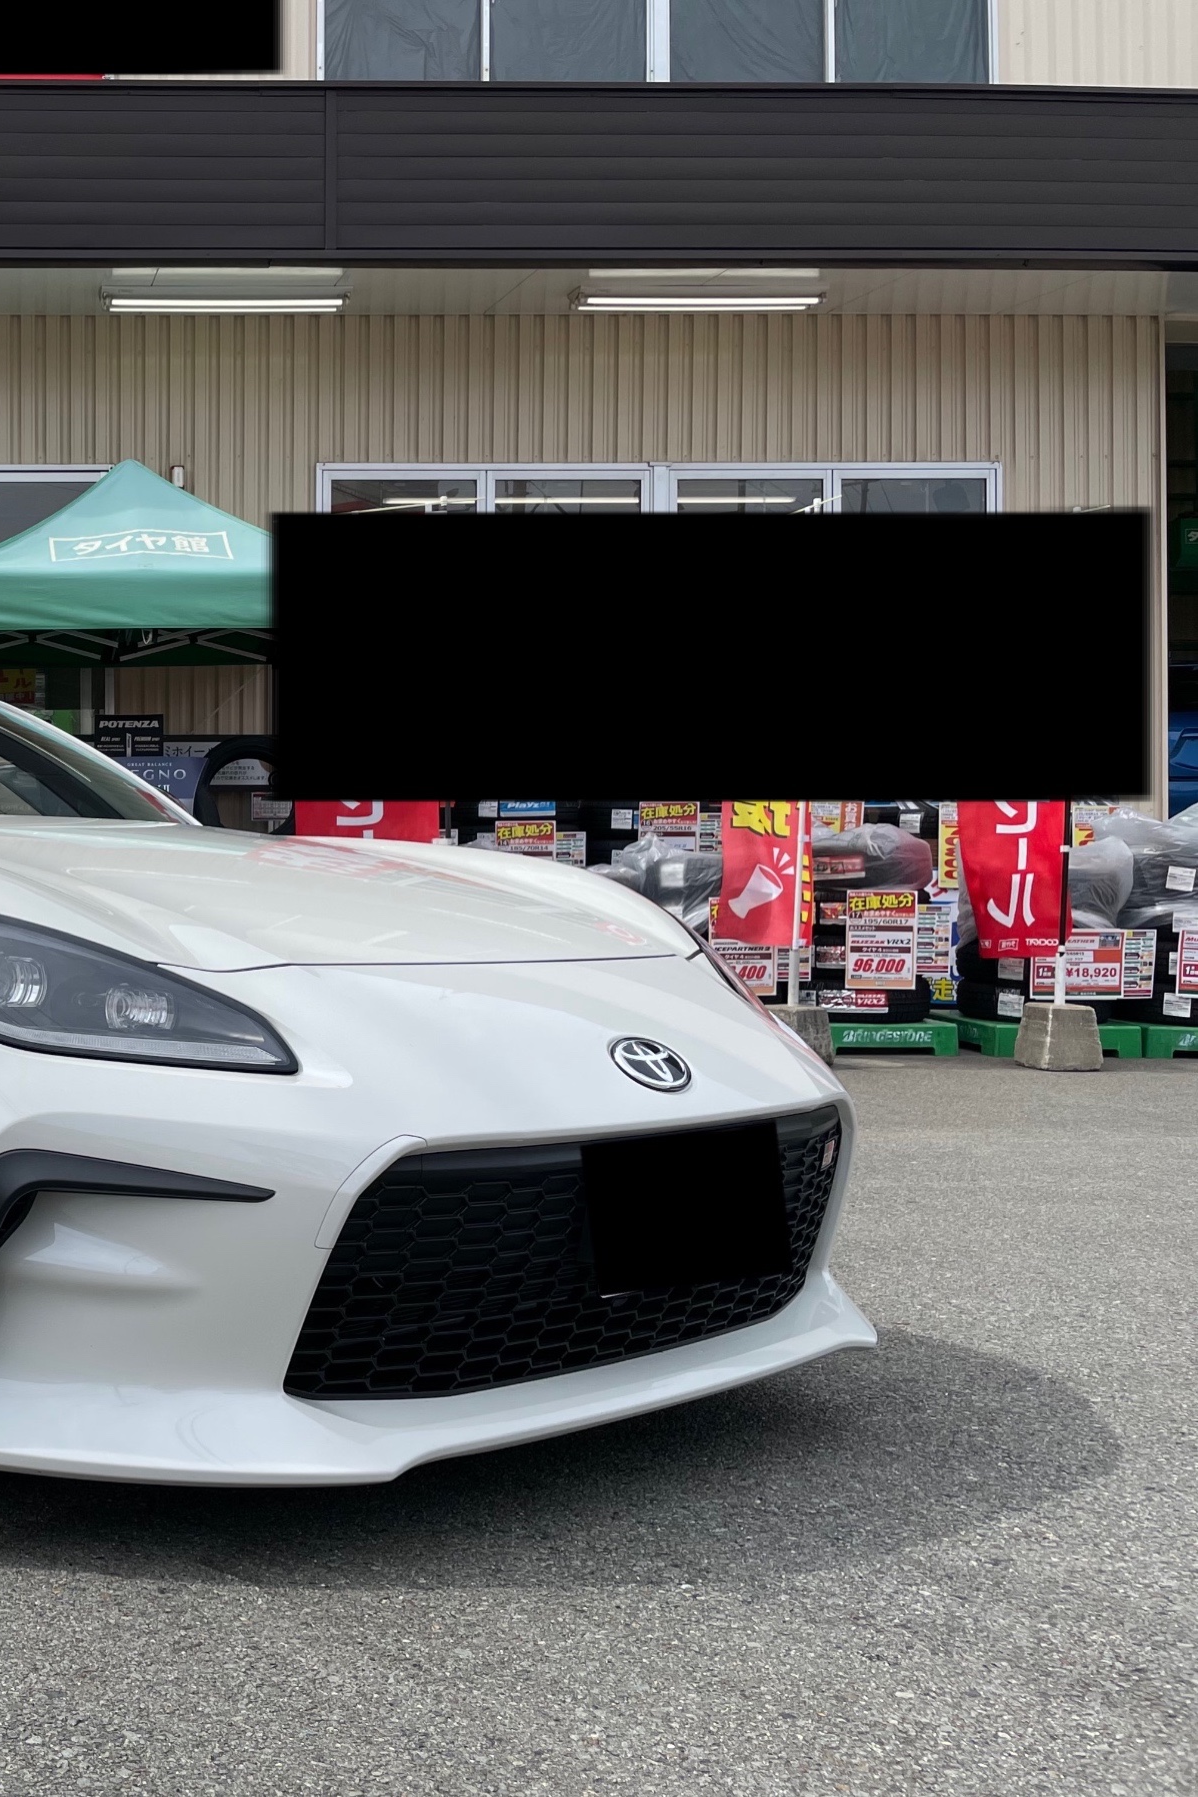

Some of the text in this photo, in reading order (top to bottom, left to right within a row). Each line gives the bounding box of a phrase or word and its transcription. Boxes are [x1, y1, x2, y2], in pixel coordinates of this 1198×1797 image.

[72, 532, 210, 557] タイヤ館
[98, 720, 160, 729] POTENZA
[165, 745, 213, 757] ミホイー
[642, 803, 696, 819] 在庫処分
[498, 823, 552, 839] 在庫処分
[849, 893, 914, 911] 在庫処分
[852, 958, 906, 974] 96,000
[1066, 967, 1117, 979] ¥18,920
